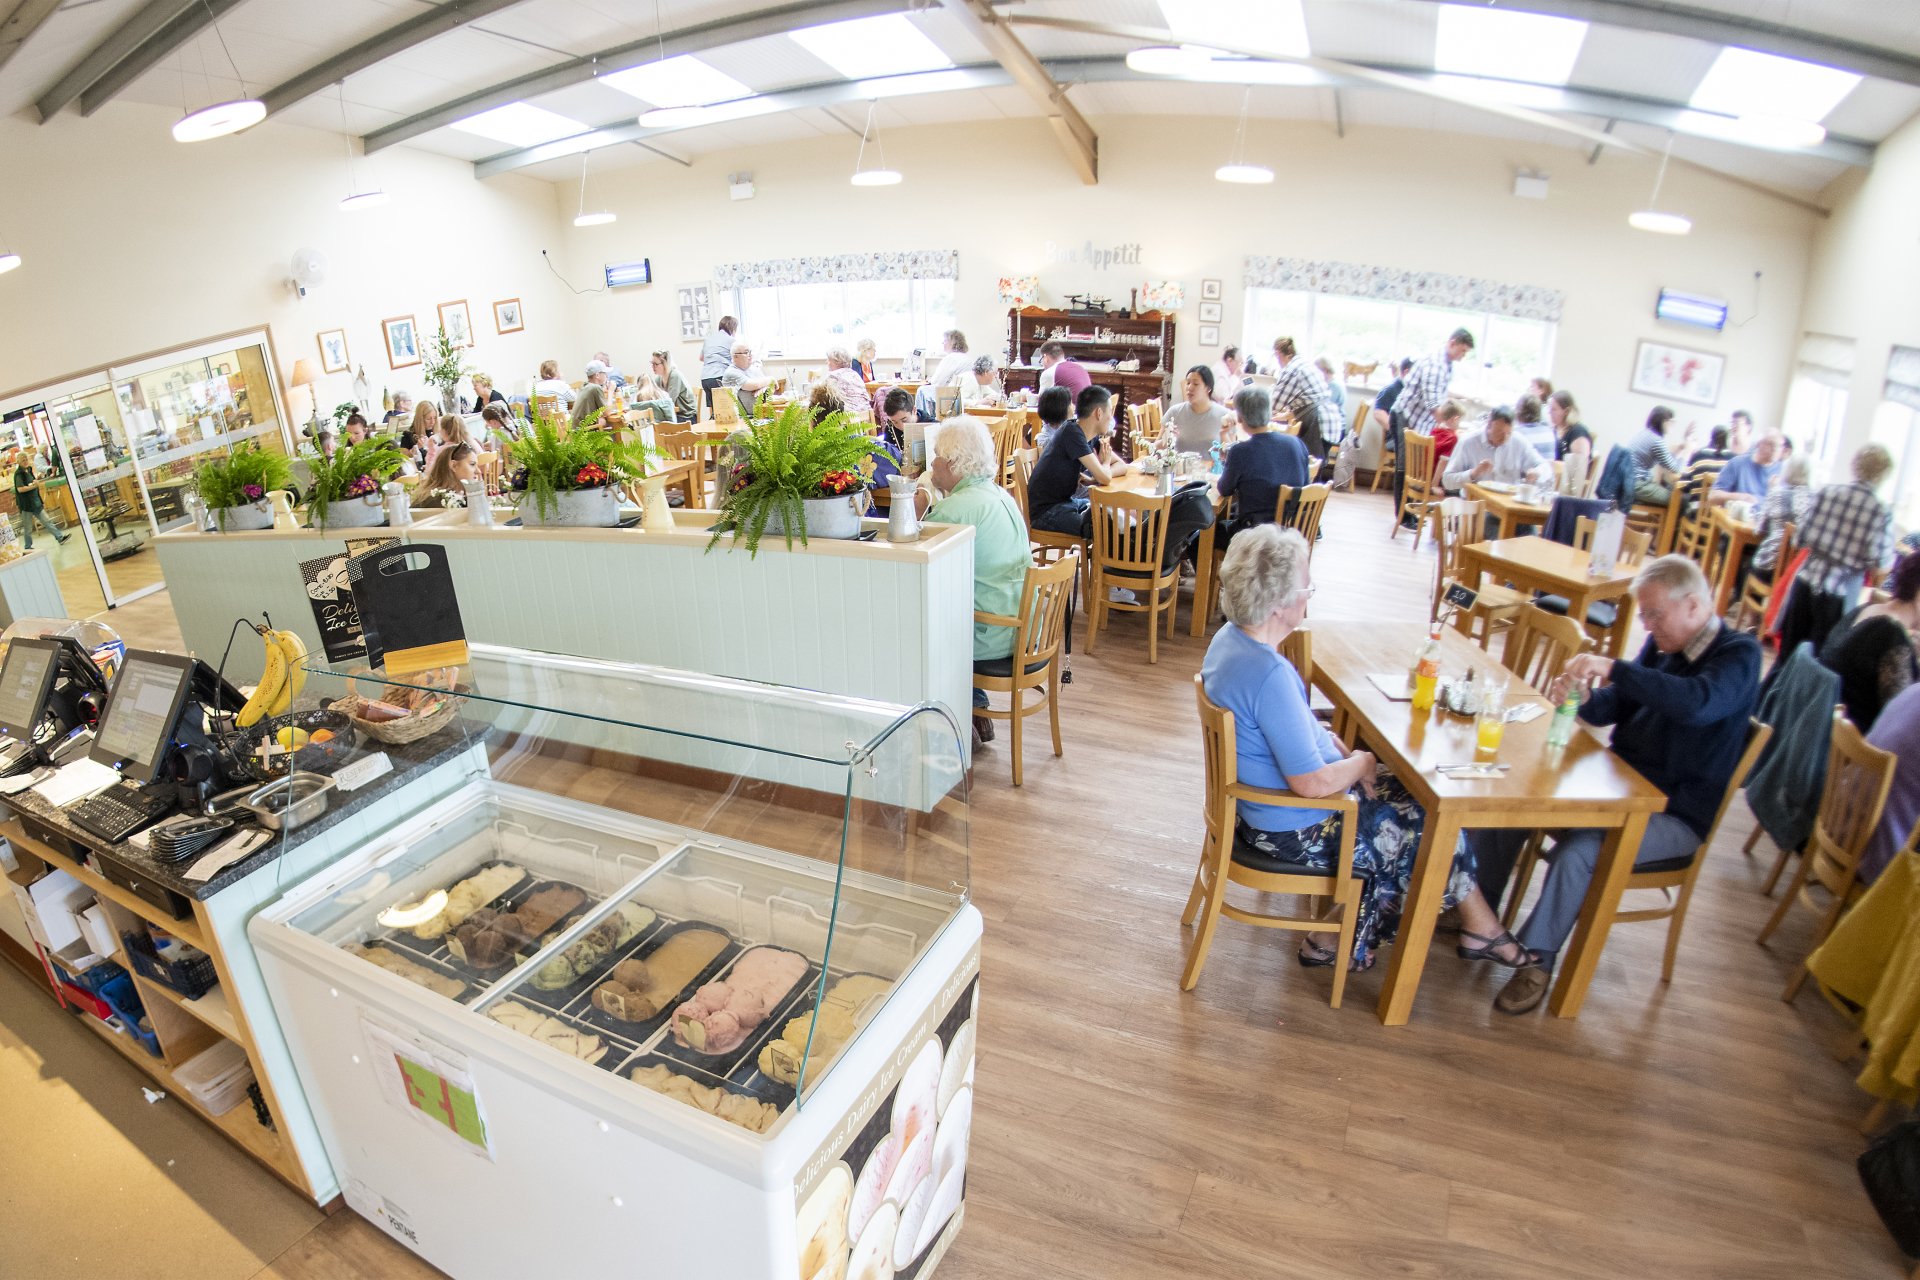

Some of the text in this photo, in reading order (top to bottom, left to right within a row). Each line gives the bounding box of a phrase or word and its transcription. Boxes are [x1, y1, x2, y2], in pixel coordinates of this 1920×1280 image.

[1044, 239, 1079, 264] Bon
[1452, 590, 1467, 600] 10
[325, 617, 347, 632] Ice
[941, 953, 978, 1008] Delicious
[847, 1087, 877, 1135] Dairy
[879, 1065, 895, 1095] Ice
[896, 1022, 928, 1067] Cream
